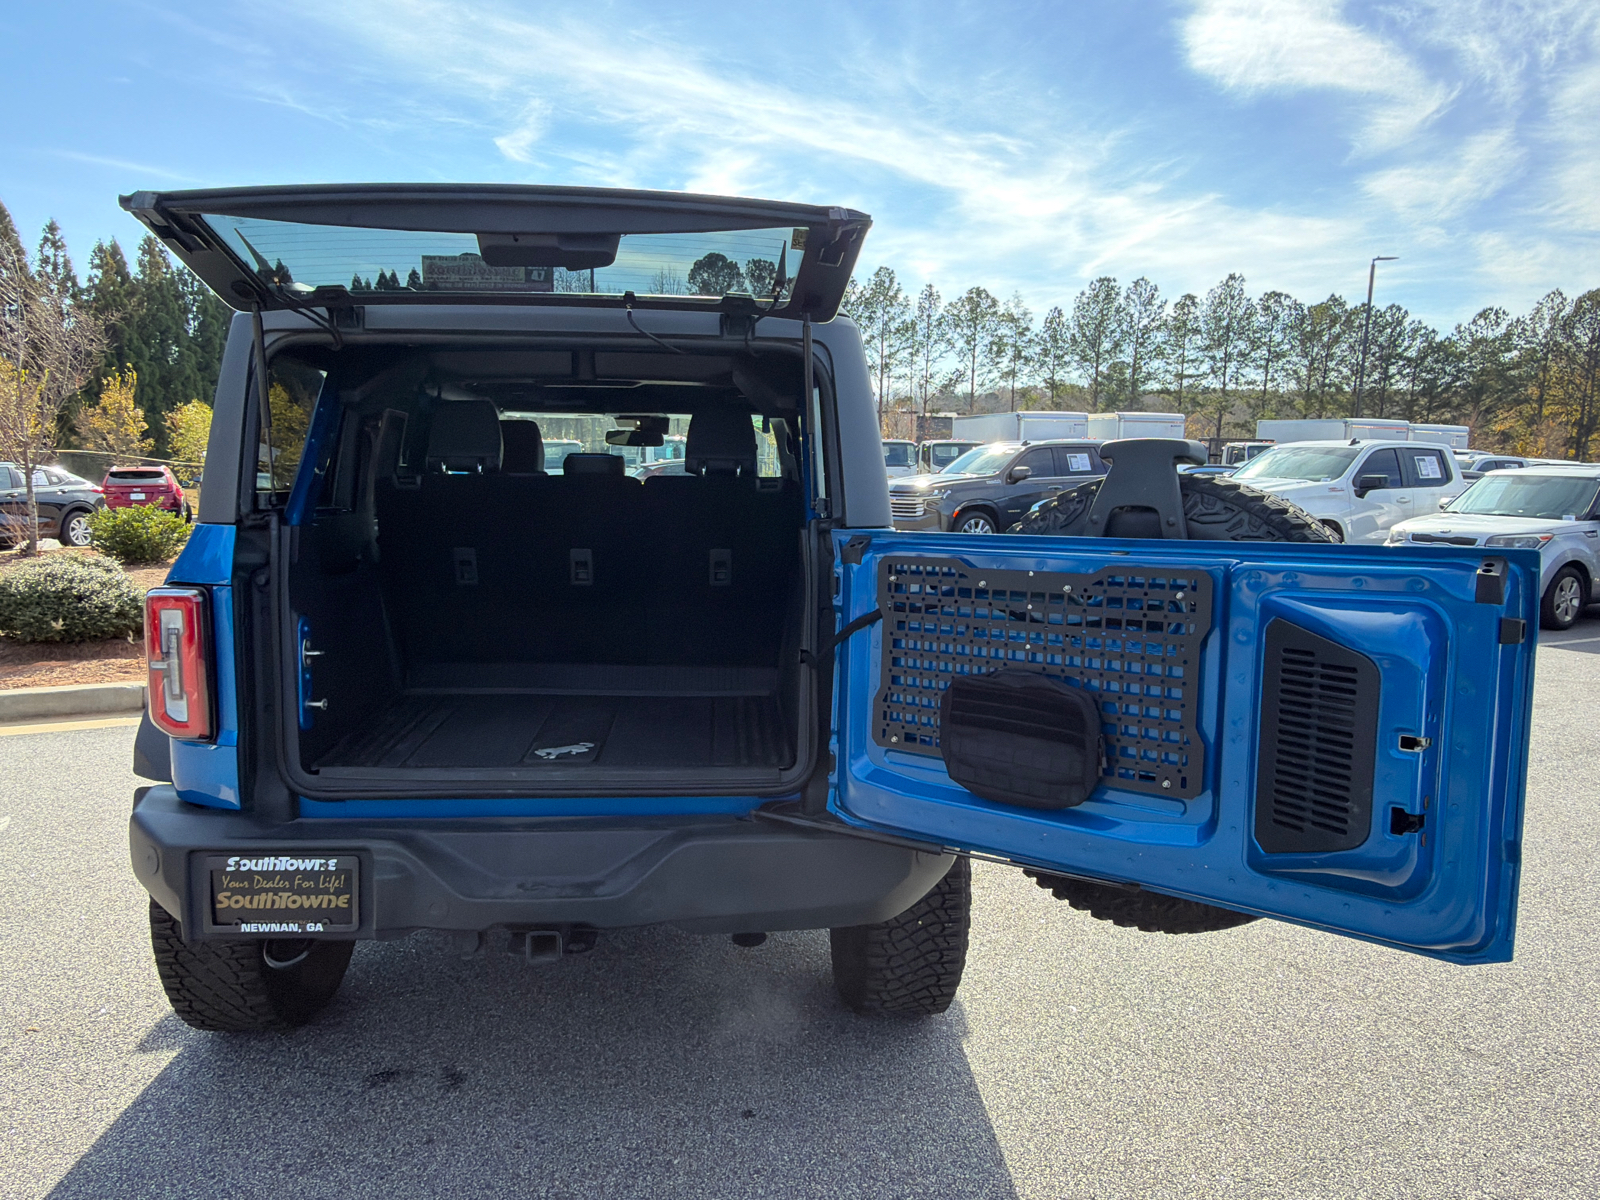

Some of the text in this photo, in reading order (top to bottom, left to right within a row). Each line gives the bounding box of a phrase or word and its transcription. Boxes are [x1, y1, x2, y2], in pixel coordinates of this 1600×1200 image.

[222, 874, 345, 893] Your Dealer For Life!
[216, 892, 350, 909] SouthTowne
[241, 923, 324, 933] NEWNAN, GA
